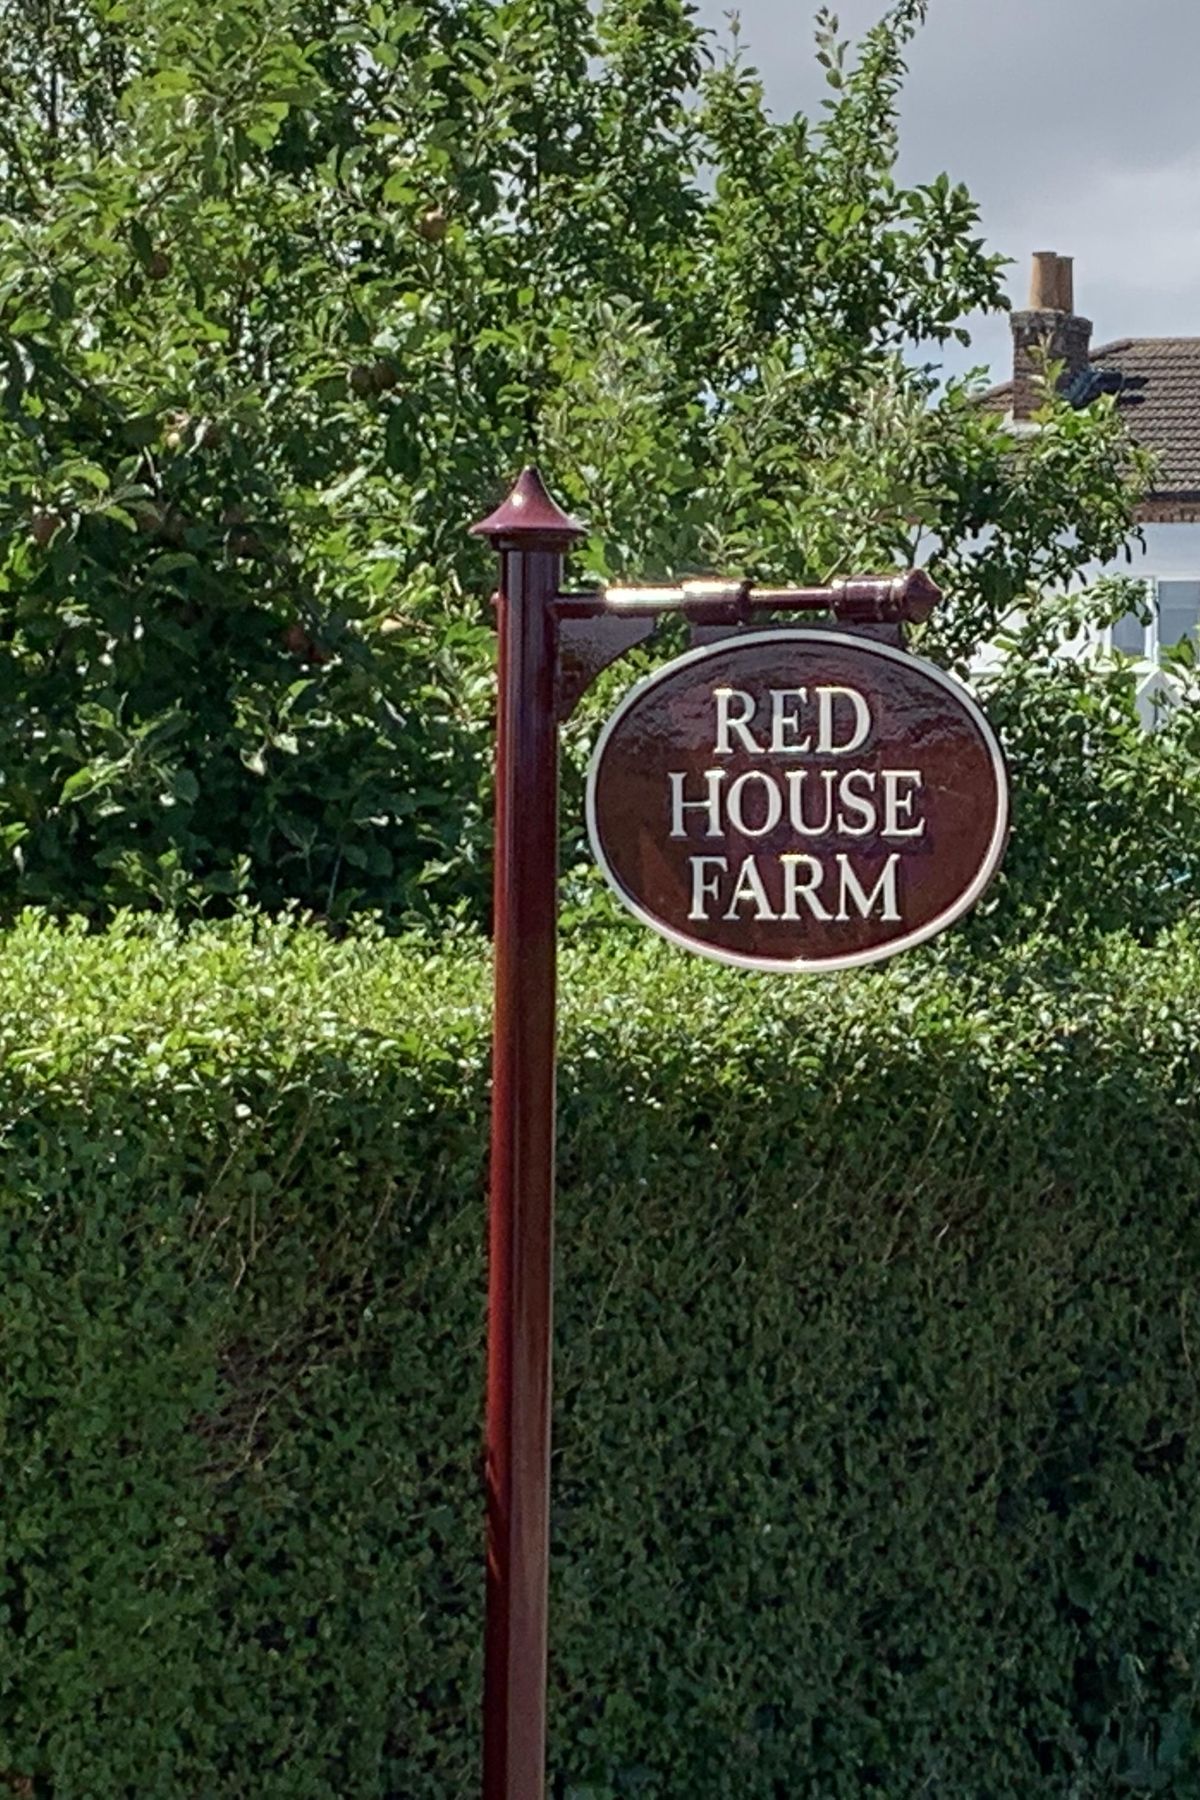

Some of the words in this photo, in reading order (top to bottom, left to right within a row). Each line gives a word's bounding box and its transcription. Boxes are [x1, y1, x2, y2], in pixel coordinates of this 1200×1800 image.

[712, 687, 872, 755] RED
[667, 769, 926, 838] HOUSE
[687, 854, 903, 922] FARM
